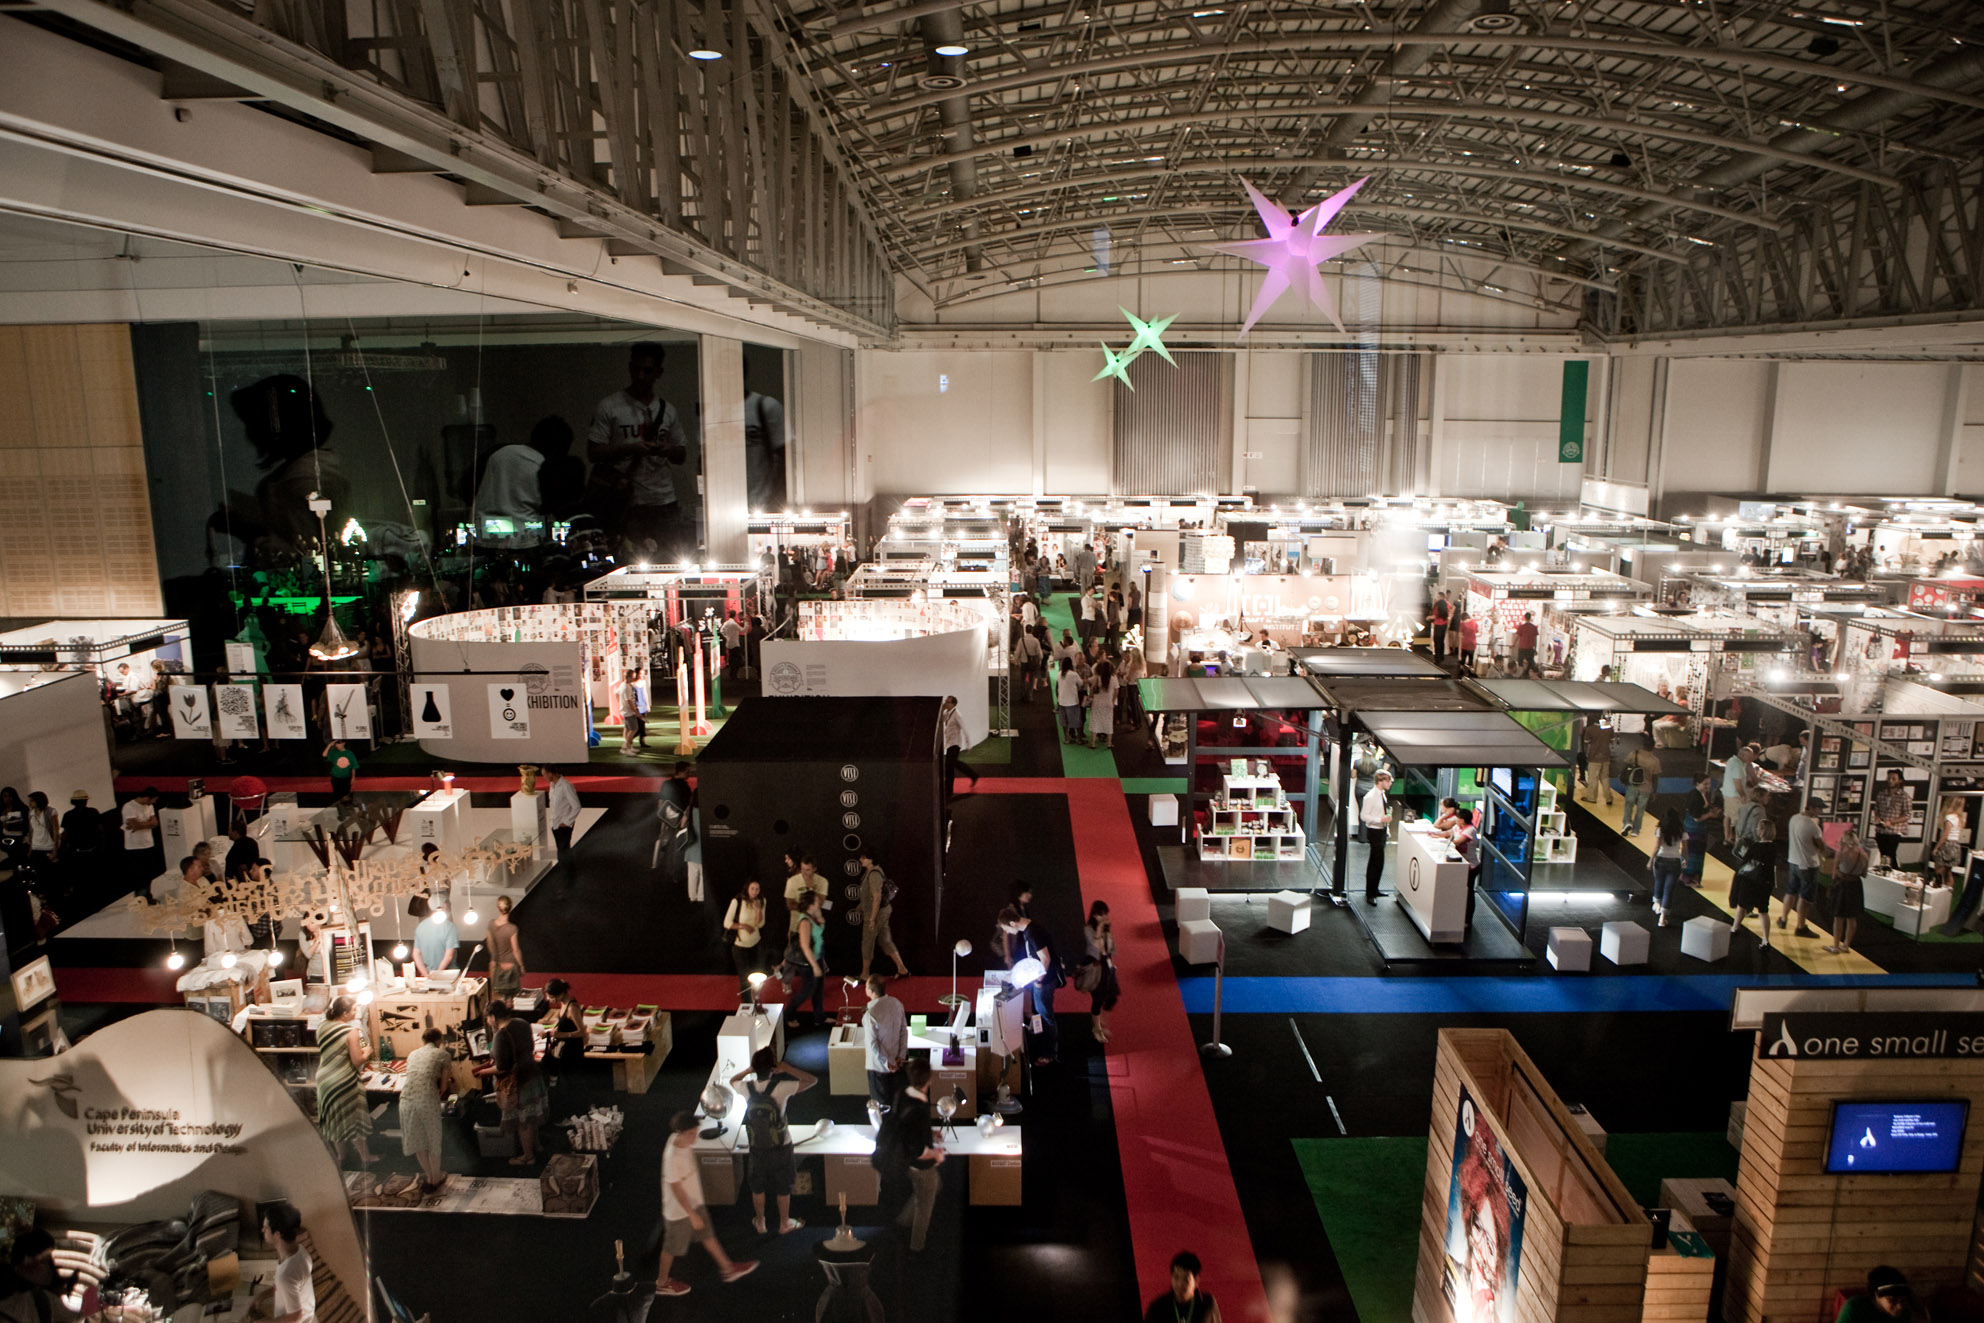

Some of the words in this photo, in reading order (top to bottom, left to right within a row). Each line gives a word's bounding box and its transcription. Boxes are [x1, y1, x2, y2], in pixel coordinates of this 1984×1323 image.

[526, 694, 578, 710] XHIBITION
[1804, 1037, 1859, 1055] one
[1869, 1029, 1948, 1055] small
[84, 1107, 118, 1122] Cape
[120, 1106, 181, 1121] Peninsula
[87, 1122, 153, 1138] University
[153, 1121, 165, 1135] of
[165, 1121, 243, 1138] Technology
[89, 1141, 124, 1154] Faculty
[126, 1141, 137, 1152] of
[138, 1141, 192, 1153] Informatics
[193, 1143, 212, 1153] and
[1474, 1130, 1487, 1155] one
[1505, 1181, 1522, 1212] seed
